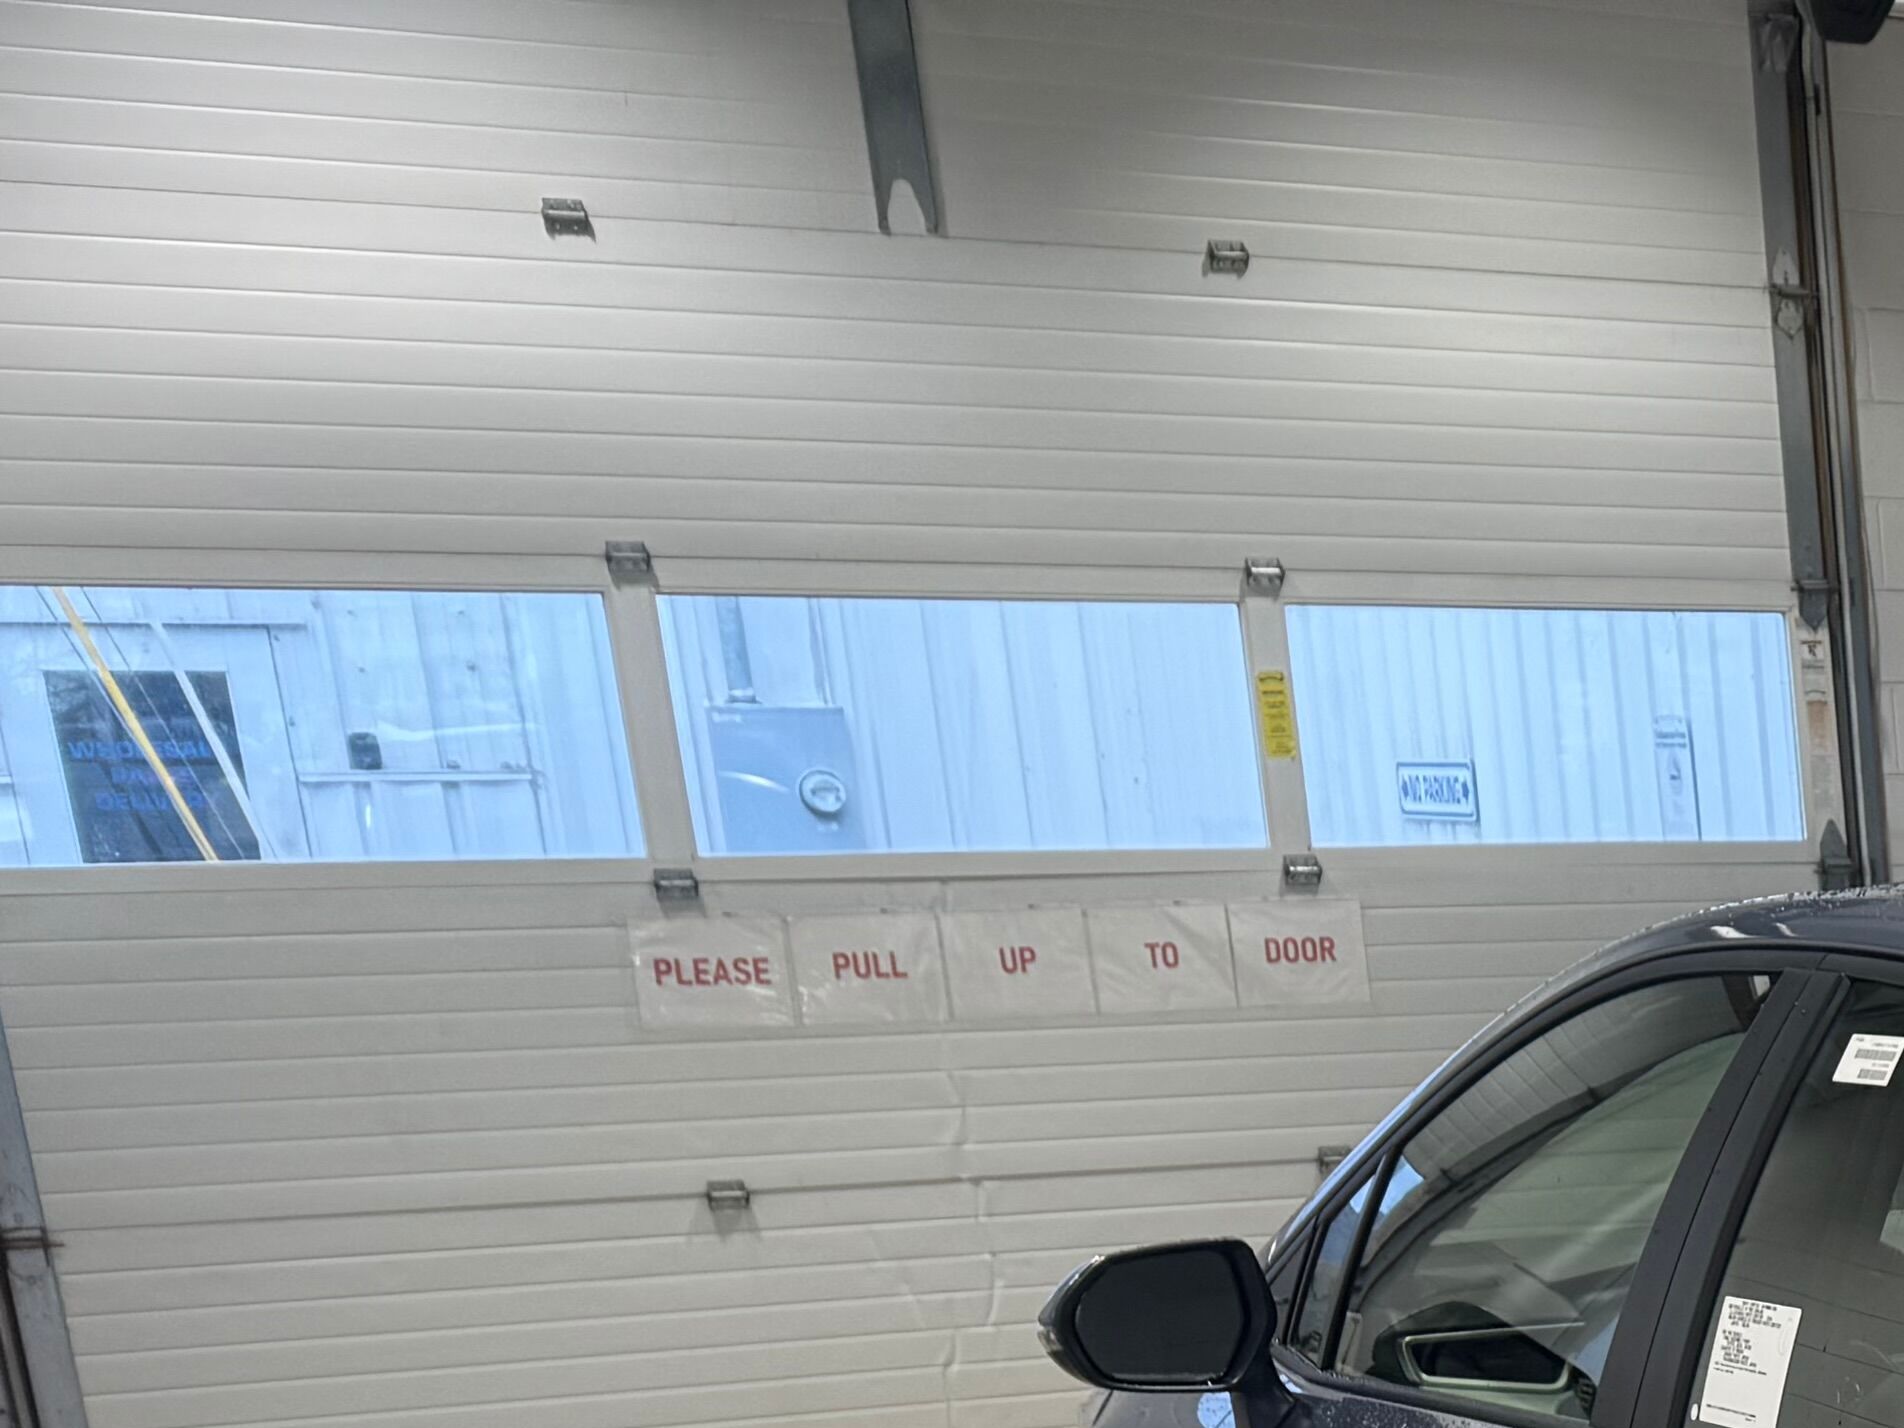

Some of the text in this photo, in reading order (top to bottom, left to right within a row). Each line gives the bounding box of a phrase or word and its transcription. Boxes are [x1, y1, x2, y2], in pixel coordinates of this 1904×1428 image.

[1407, 774, 1461, 804] NO PARKING
[653, 936, 1337, 986] PLEASE PULL UP TO DOOR
